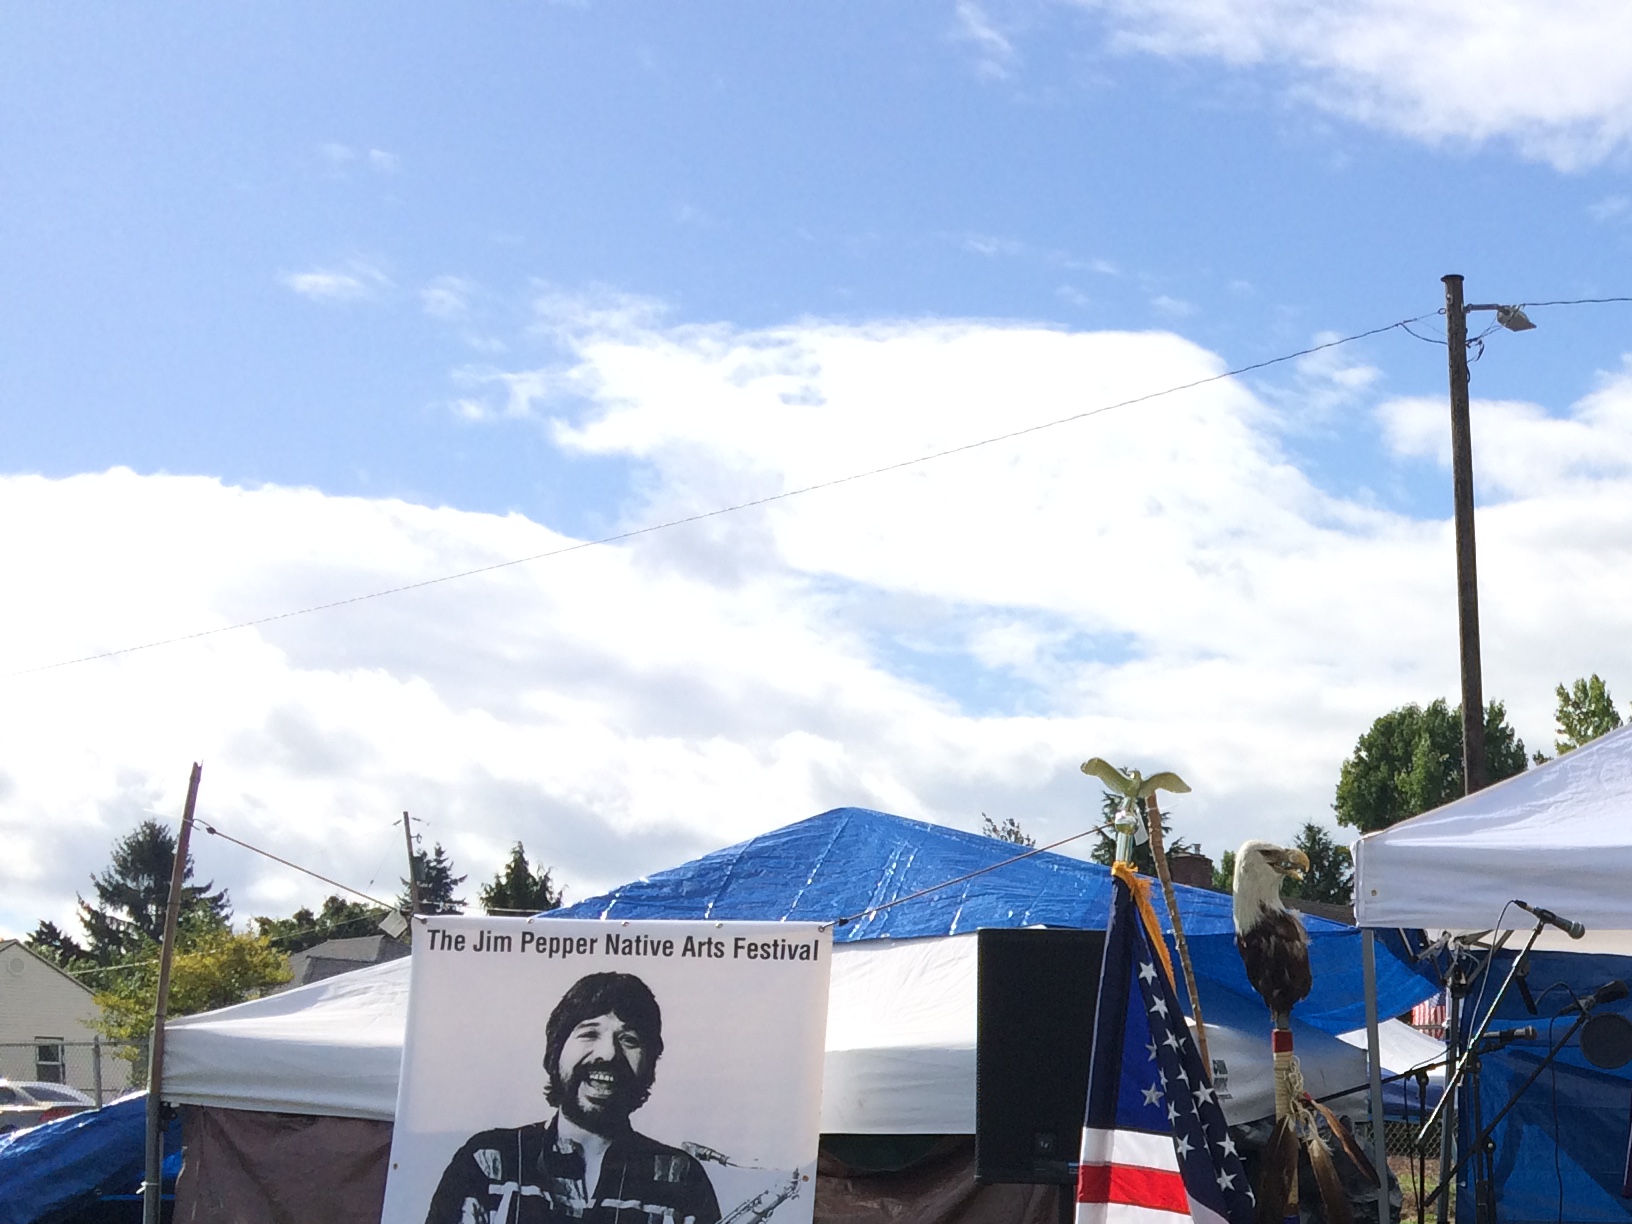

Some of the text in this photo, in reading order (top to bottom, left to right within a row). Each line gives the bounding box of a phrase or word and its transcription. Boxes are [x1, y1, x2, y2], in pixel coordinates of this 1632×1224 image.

[427, 929, 819, 961] The Jim Pepper Native Arts Festival
